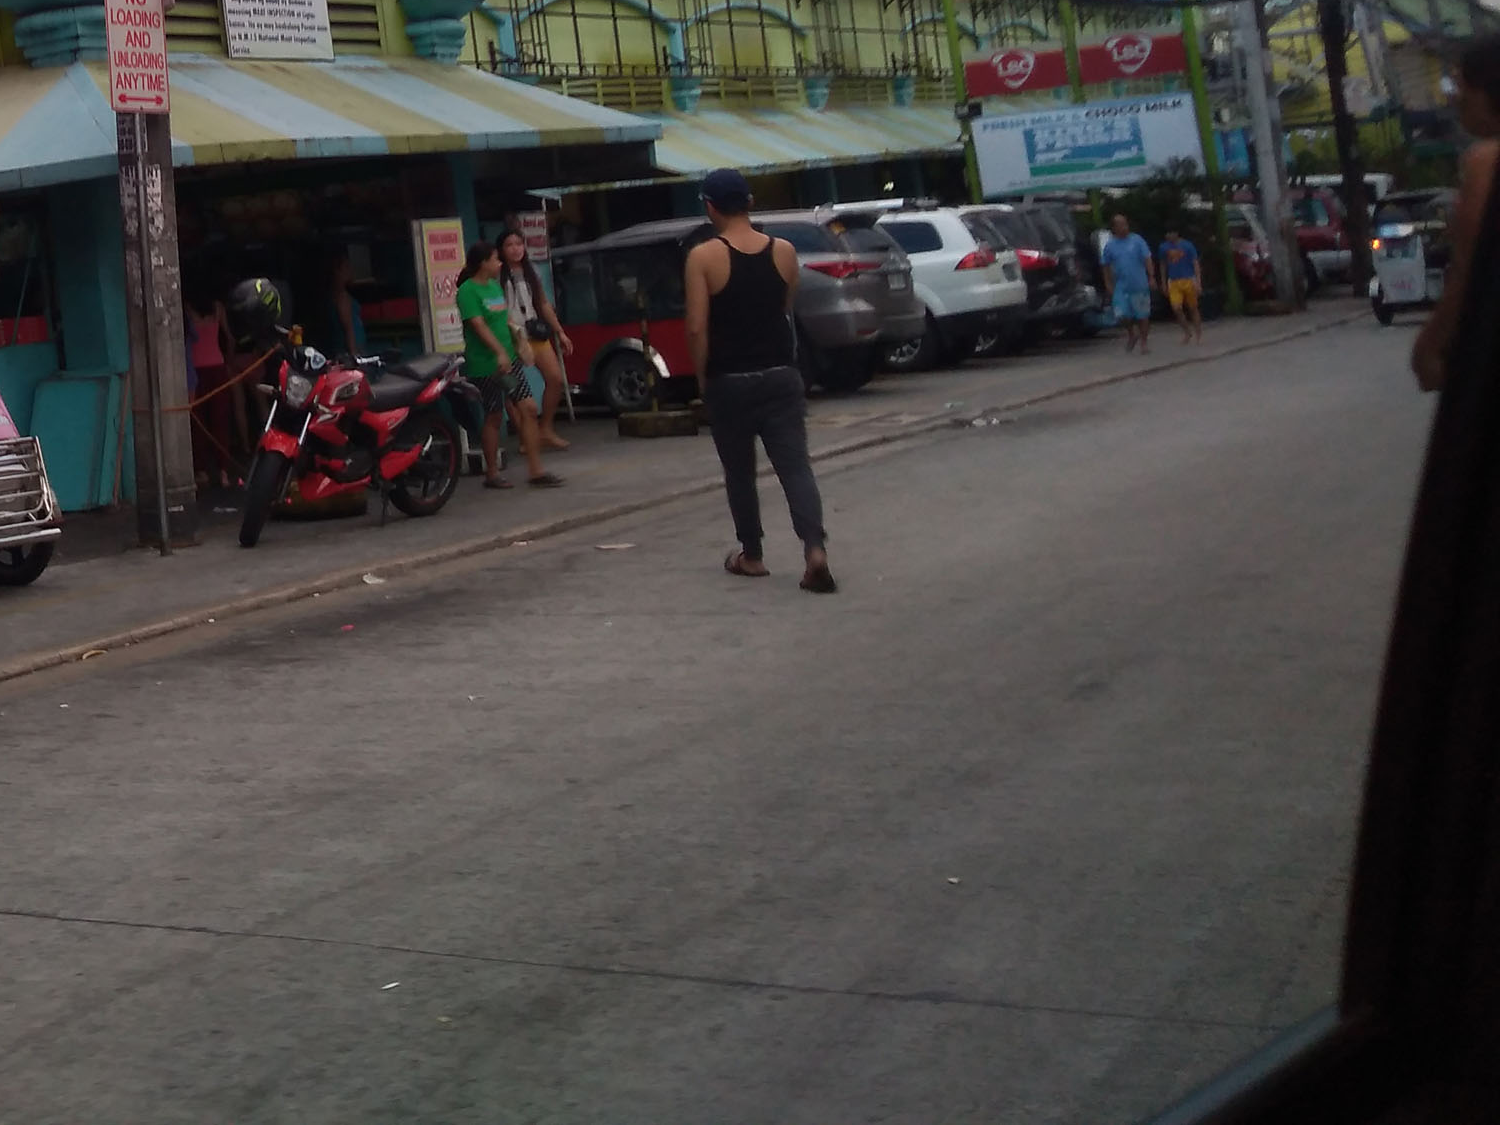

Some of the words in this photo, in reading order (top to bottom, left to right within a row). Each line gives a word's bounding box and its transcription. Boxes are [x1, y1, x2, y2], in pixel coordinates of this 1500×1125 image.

[110, 8, 161, 29] LOADING
[125, 31, 151, 49] AND
[114, 50, 164, 70] UNLOADING
[116, 73, 166, 92] ANYTIME
